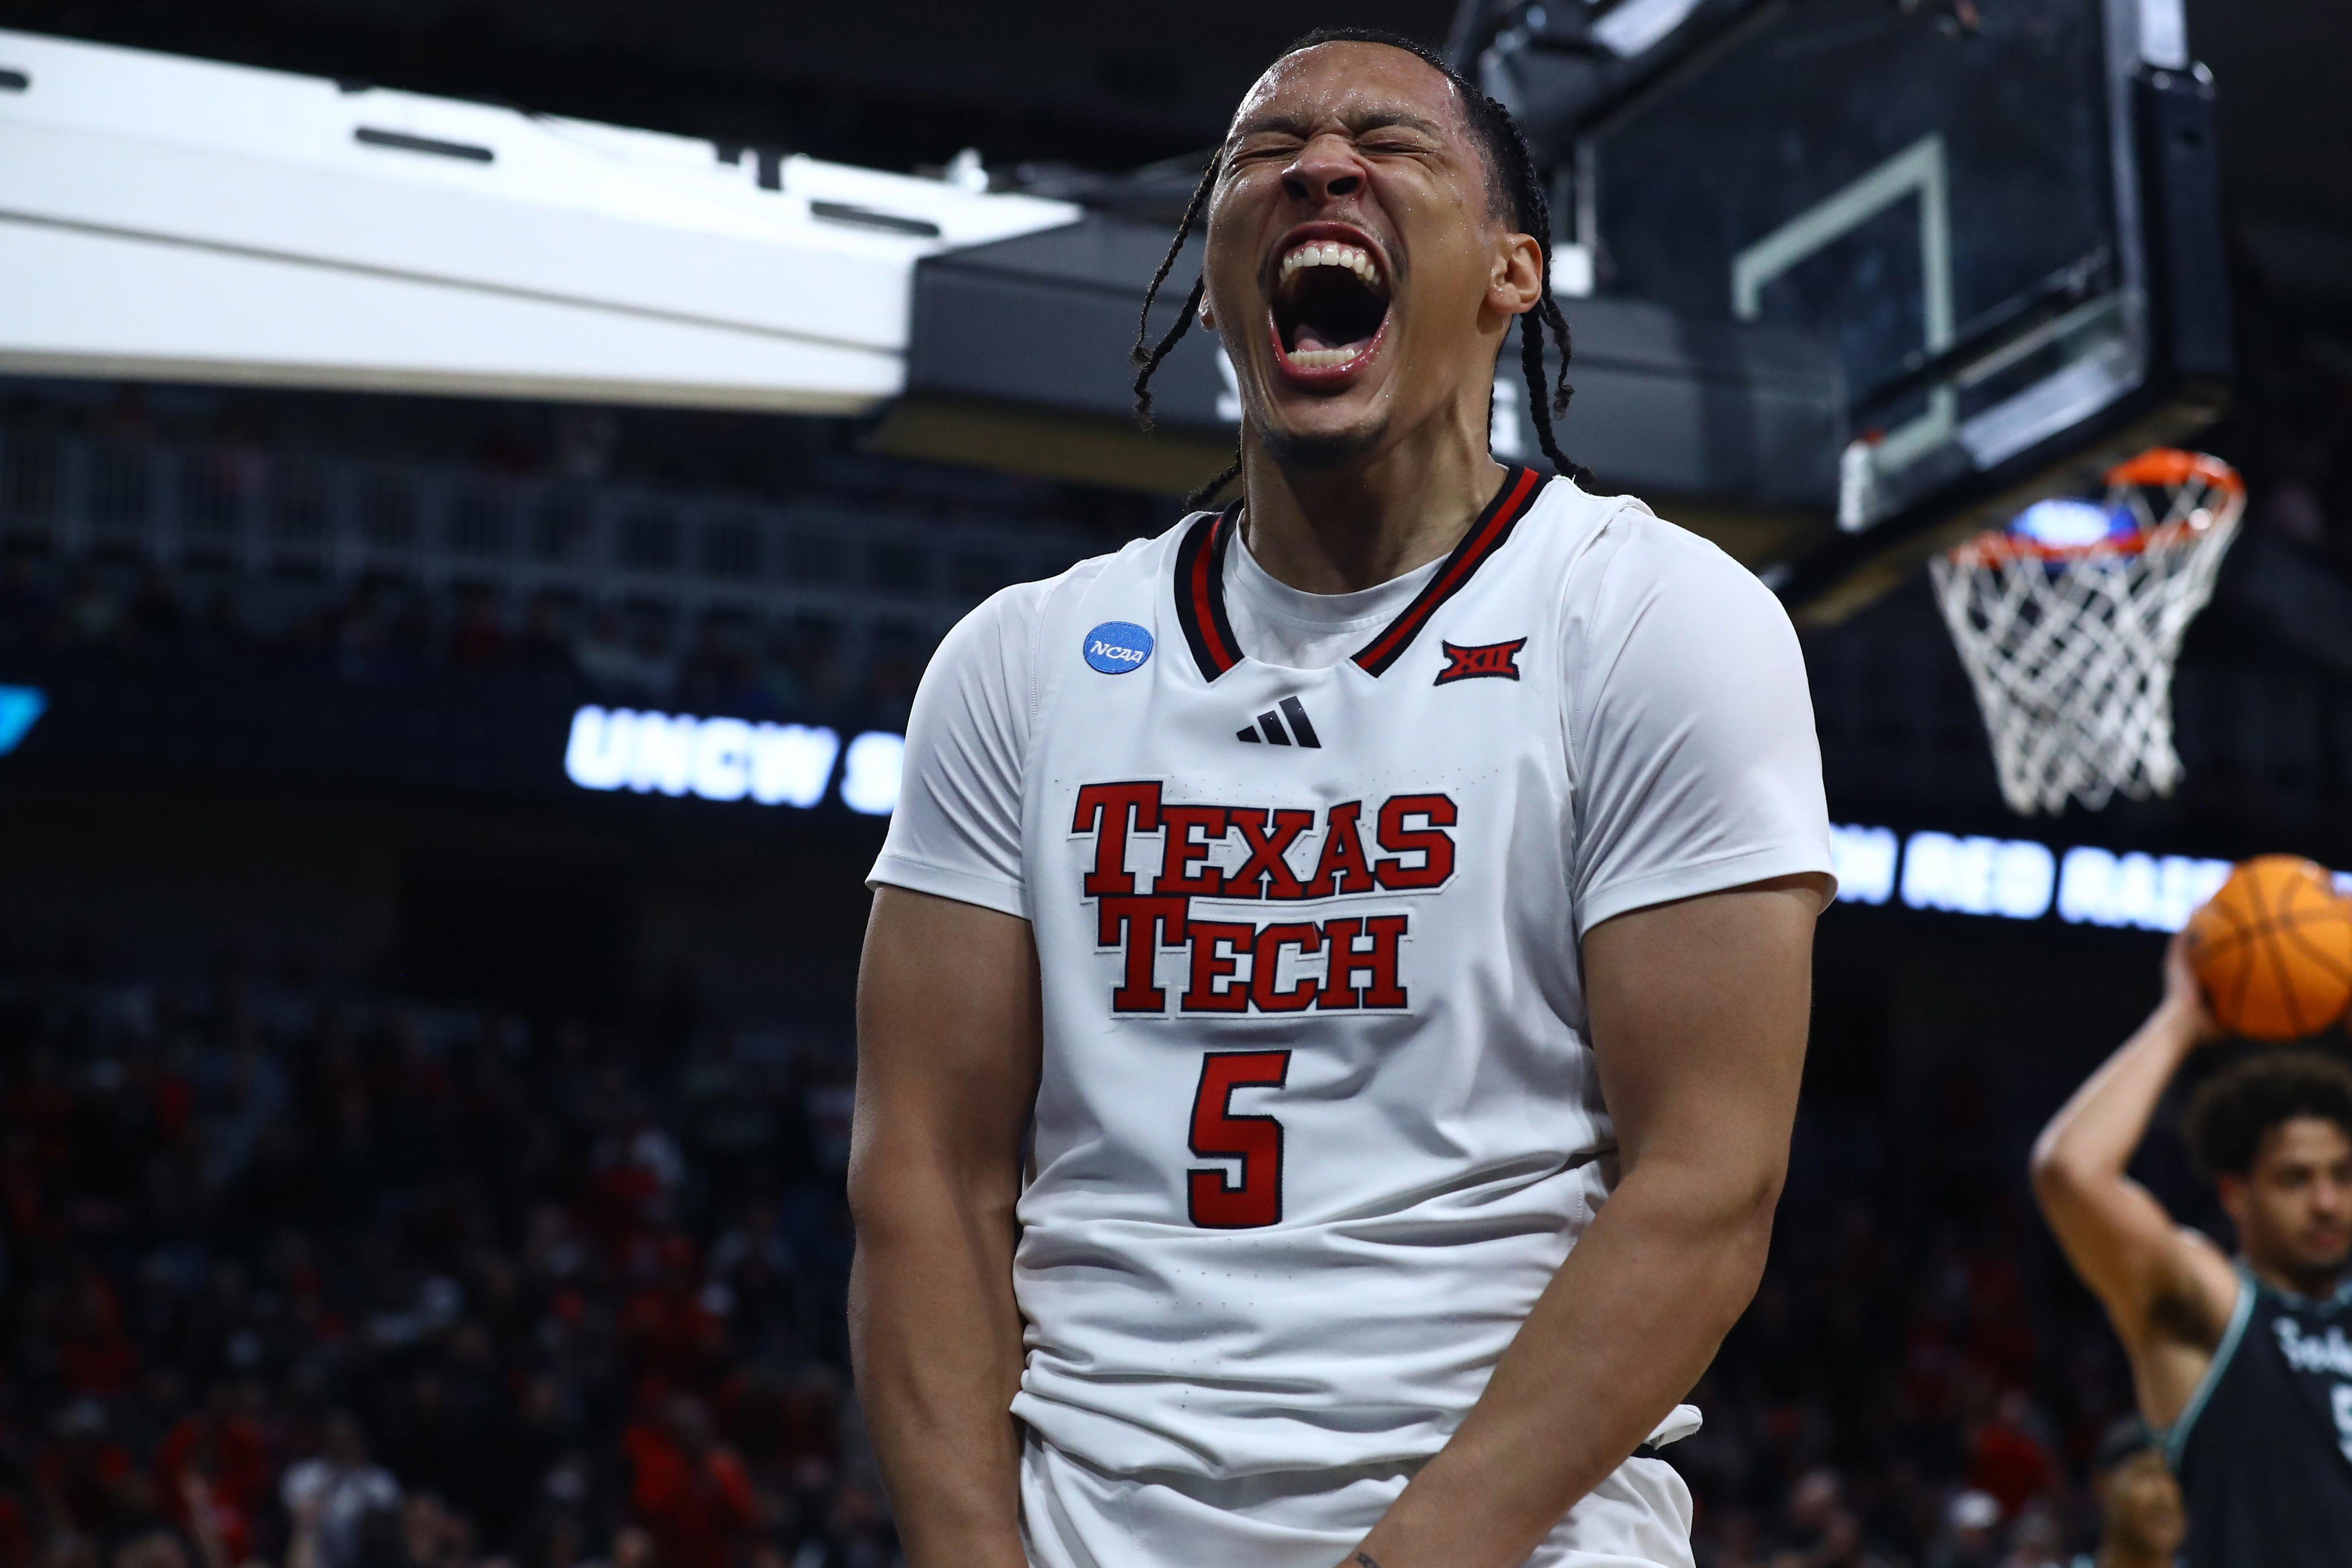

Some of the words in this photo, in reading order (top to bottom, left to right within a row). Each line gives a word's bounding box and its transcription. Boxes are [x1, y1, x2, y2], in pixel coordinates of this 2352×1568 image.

[1090, 640, 1144, 664] NCAA
[1441, 640, 1521, 680] XII
[565, 704, 838, 809] UNCW
[1071, 780, 1458, 900] TEXAS
[1097, 896, 1409, 1013] TECH
[1187, 1049, 1292, 1230] 5
